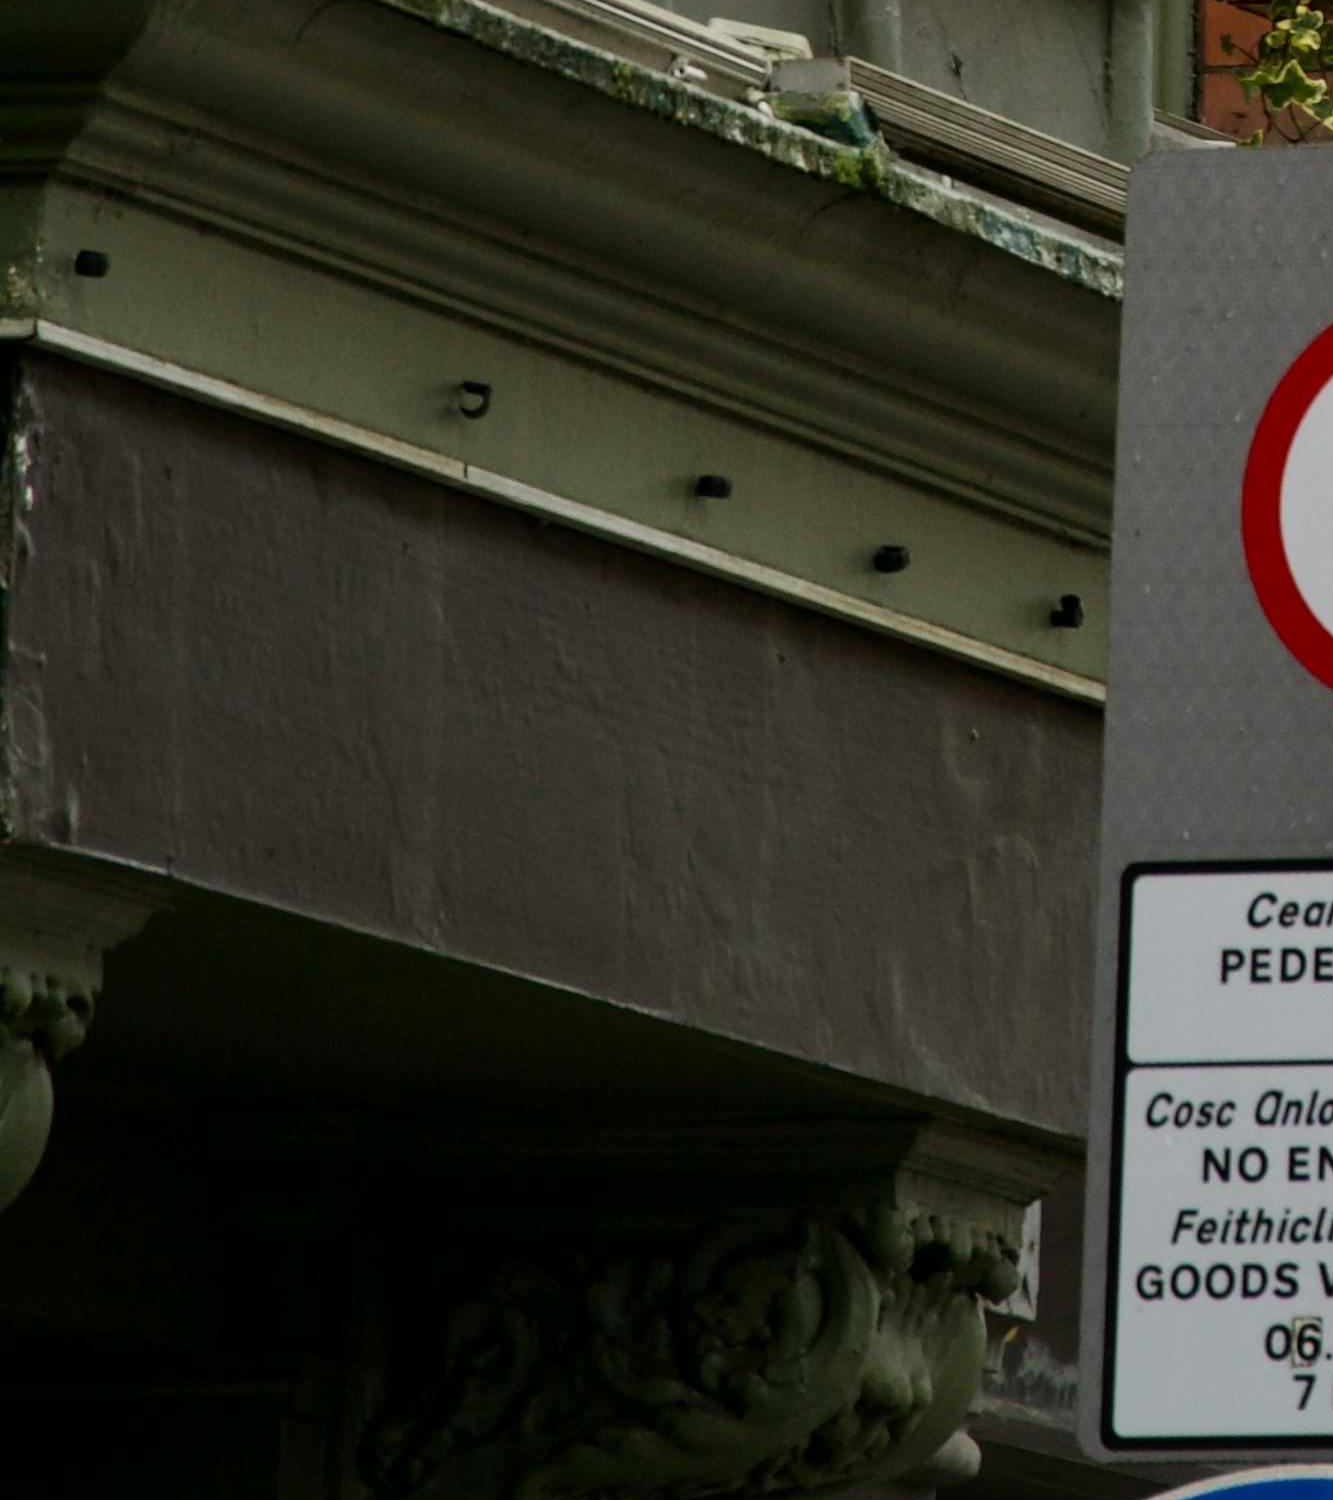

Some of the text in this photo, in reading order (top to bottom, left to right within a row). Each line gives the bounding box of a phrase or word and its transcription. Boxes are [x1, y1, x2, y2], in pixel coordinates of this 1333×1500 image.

[1145, 1092, 1237, 1129] Cosc
[1202, 1146, 1269, 1184] NO
[1135, 1261, 1300, 1302] GOODS
[1293, 1373, 1317, 1411] 7
